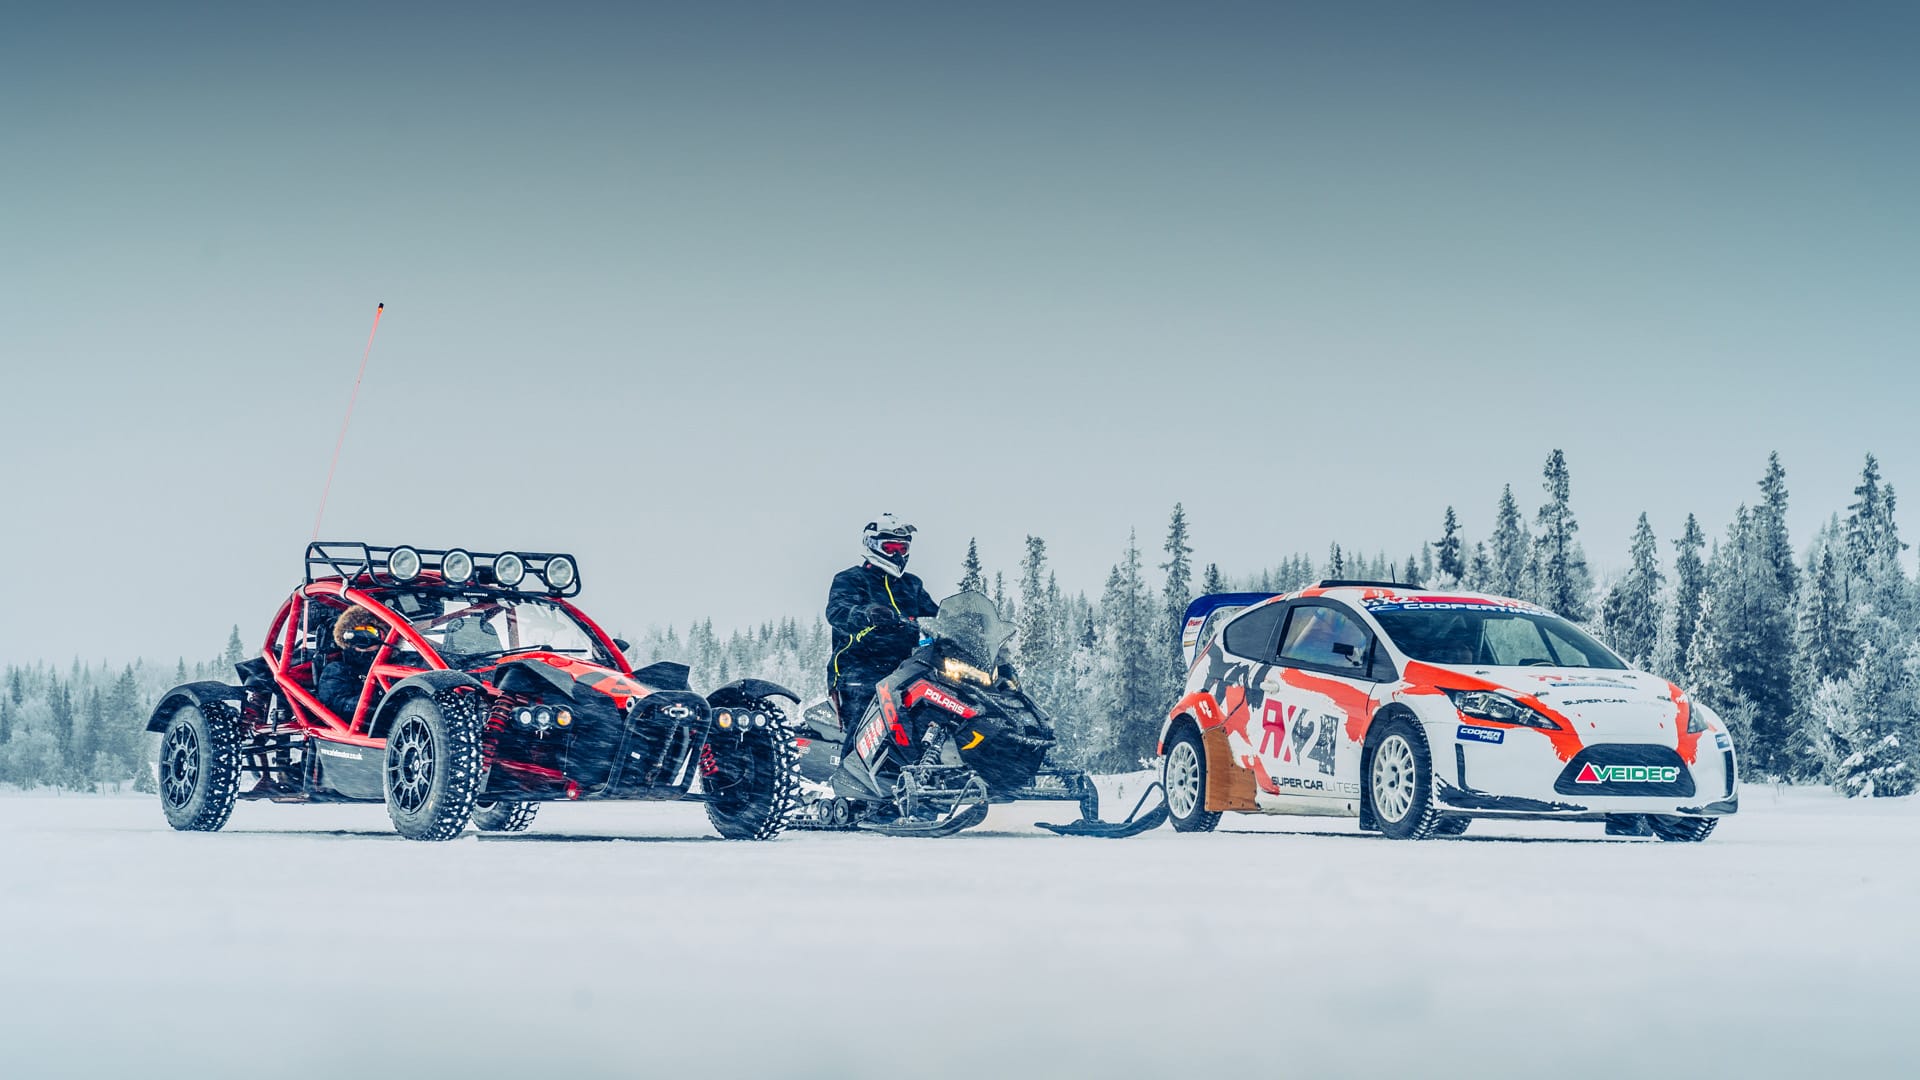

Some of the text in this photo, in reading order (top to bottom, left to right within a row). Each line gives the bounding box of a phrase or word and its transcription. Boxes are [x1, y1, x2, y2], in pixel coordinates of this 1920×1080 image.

[924, 688, 964, 714] POLARIS
[1460, 727, 1502, 737] COOPER
[1592, 765, 1677, 782] VEIDEC
[1271, 776, 1360, 794] SUPER CAR LITES
